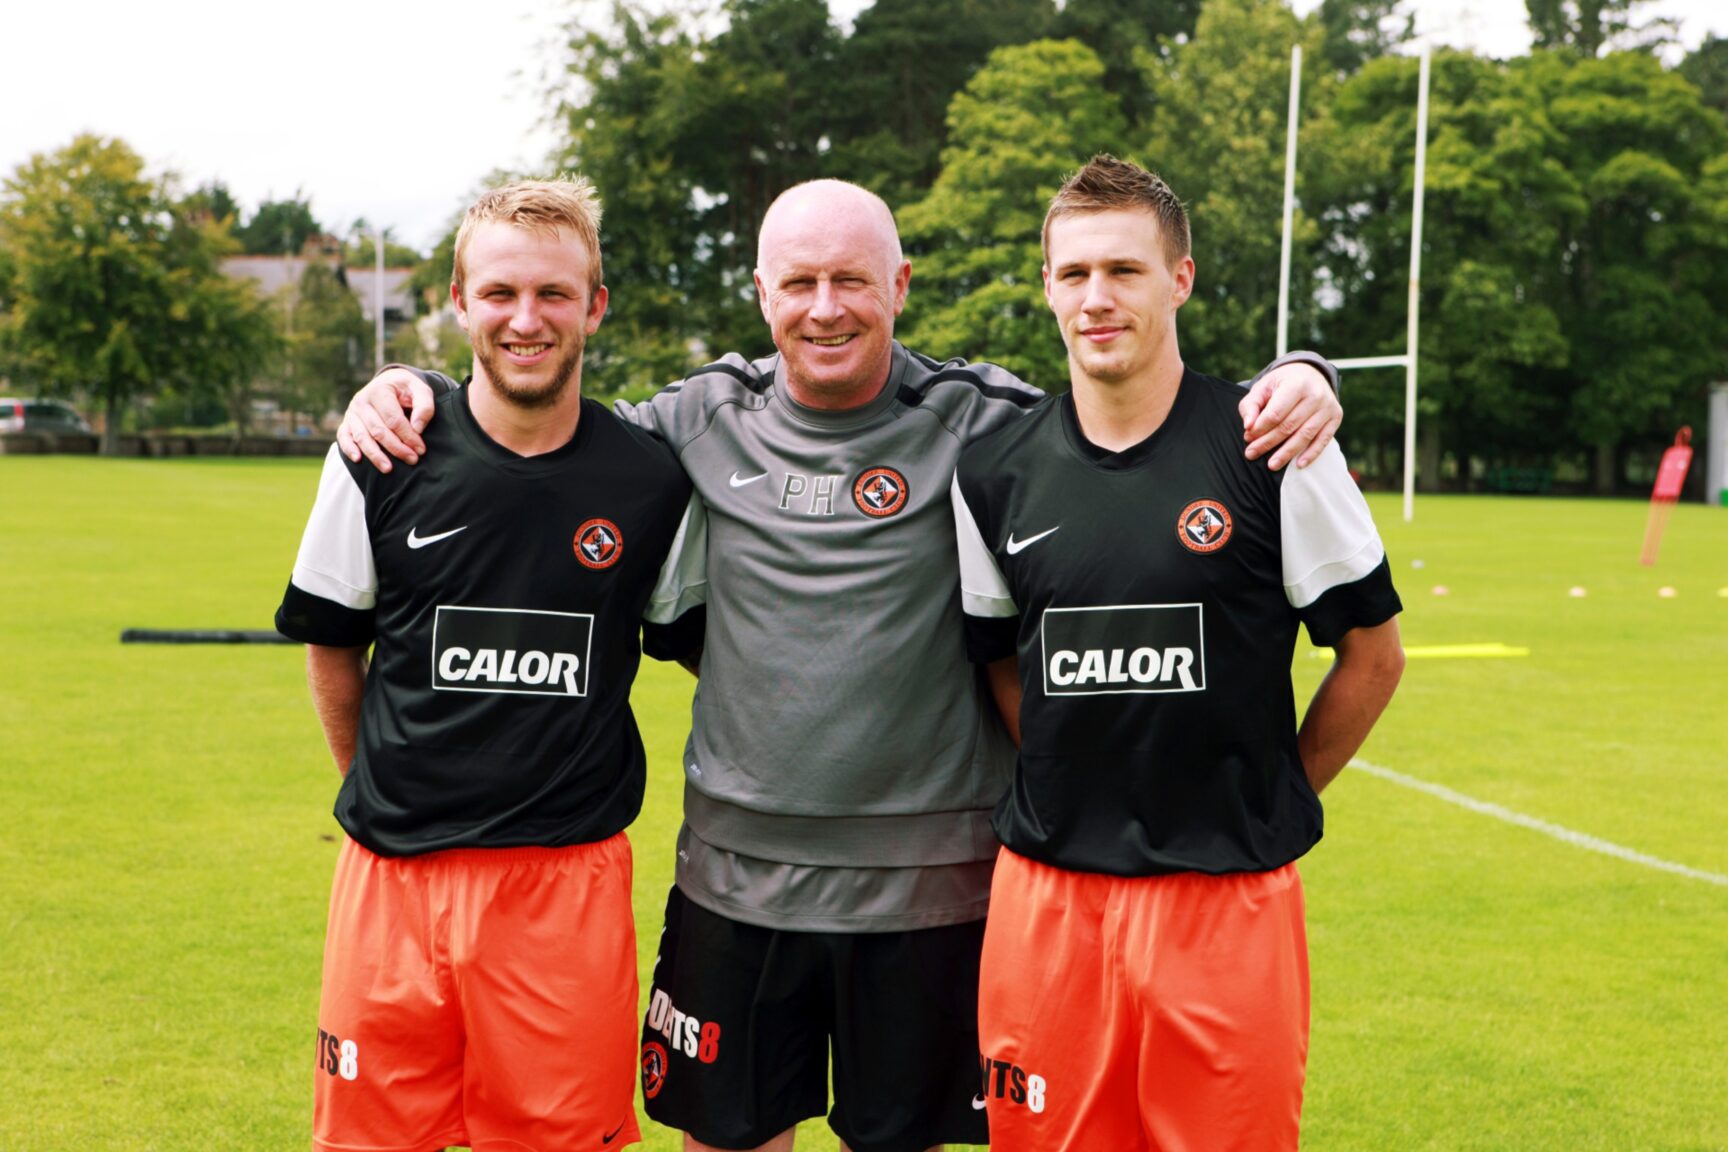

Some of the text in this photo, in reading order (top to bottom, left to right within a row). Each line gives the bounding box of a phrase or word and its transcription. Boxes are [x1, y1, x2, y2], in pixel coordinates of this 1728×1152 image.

[778, 472, 838, 515] PH
[438, 646, 580, 694] CALOR
[1049, 647, 1198, 689] CALOR
